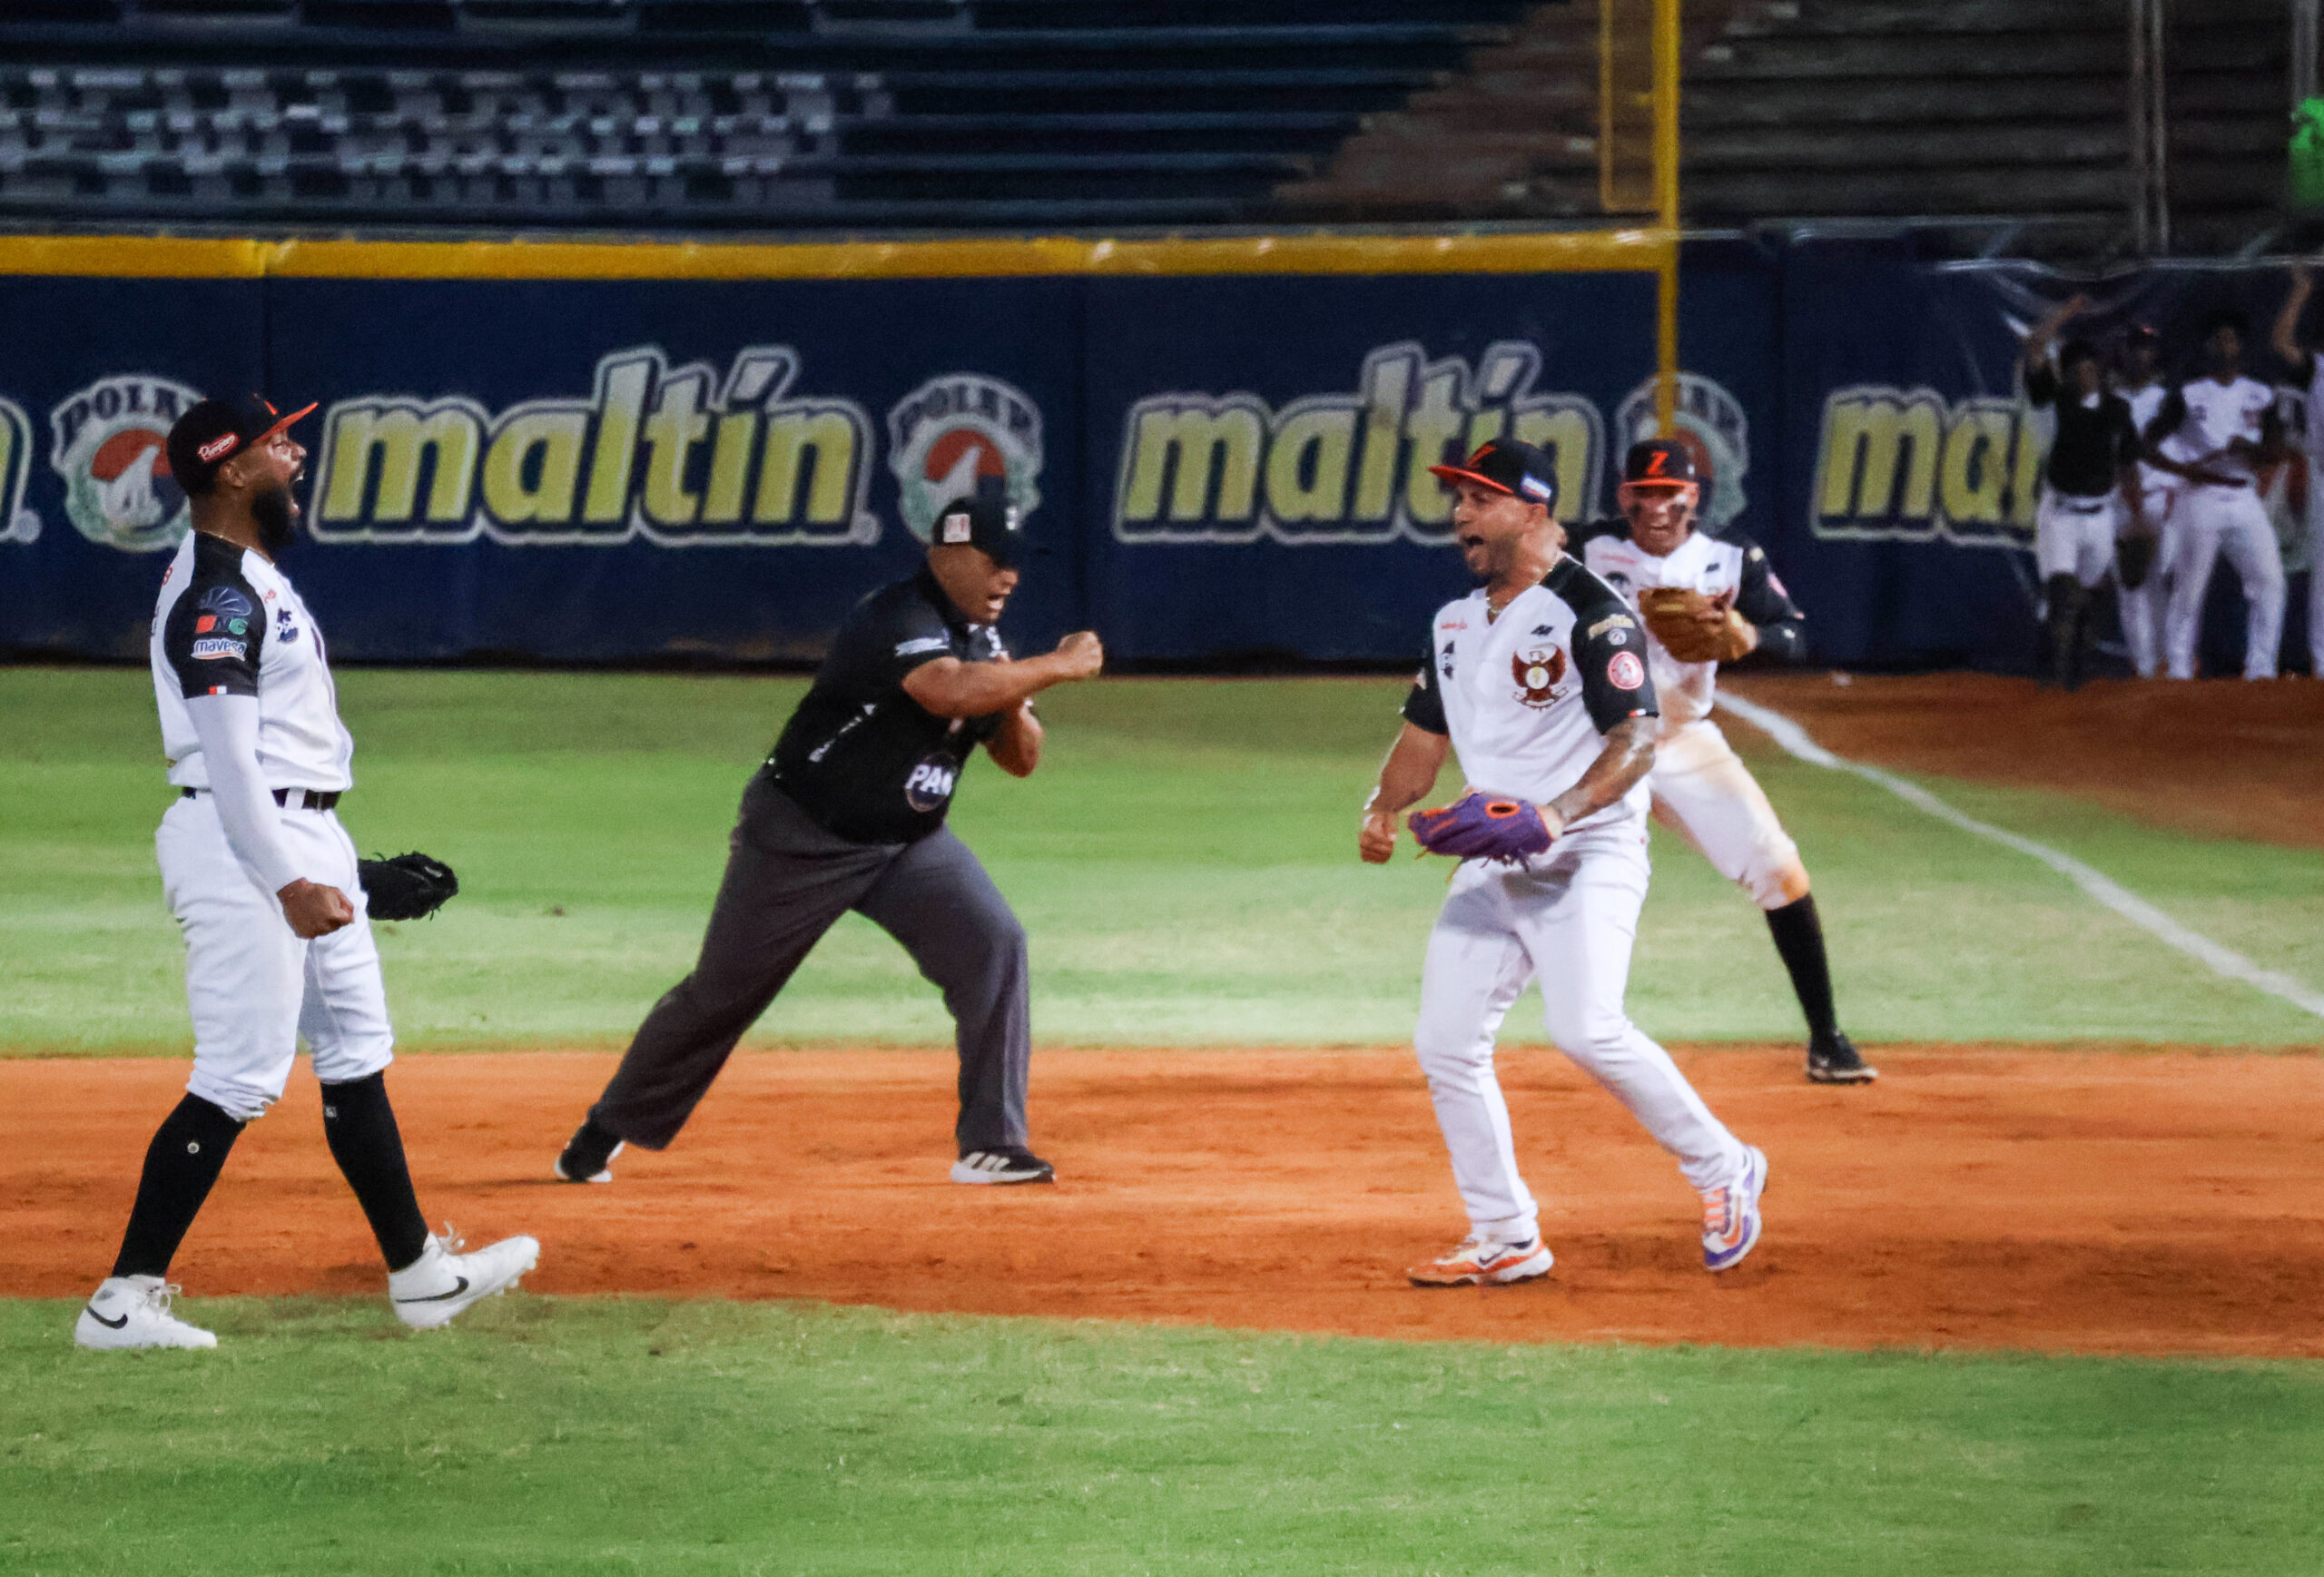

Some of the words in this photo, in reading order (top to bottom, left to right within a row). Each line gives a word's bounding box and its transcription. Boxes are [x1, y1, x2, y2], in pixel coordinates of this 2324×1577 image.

[59, 384, 198, 463] POLA
[318, 354, 861, 532] maltín
[1815, 392, 2053, 527] mal
[1645, 451, 1669, 476] Z
[194, 640, 246, 655] mavesa
